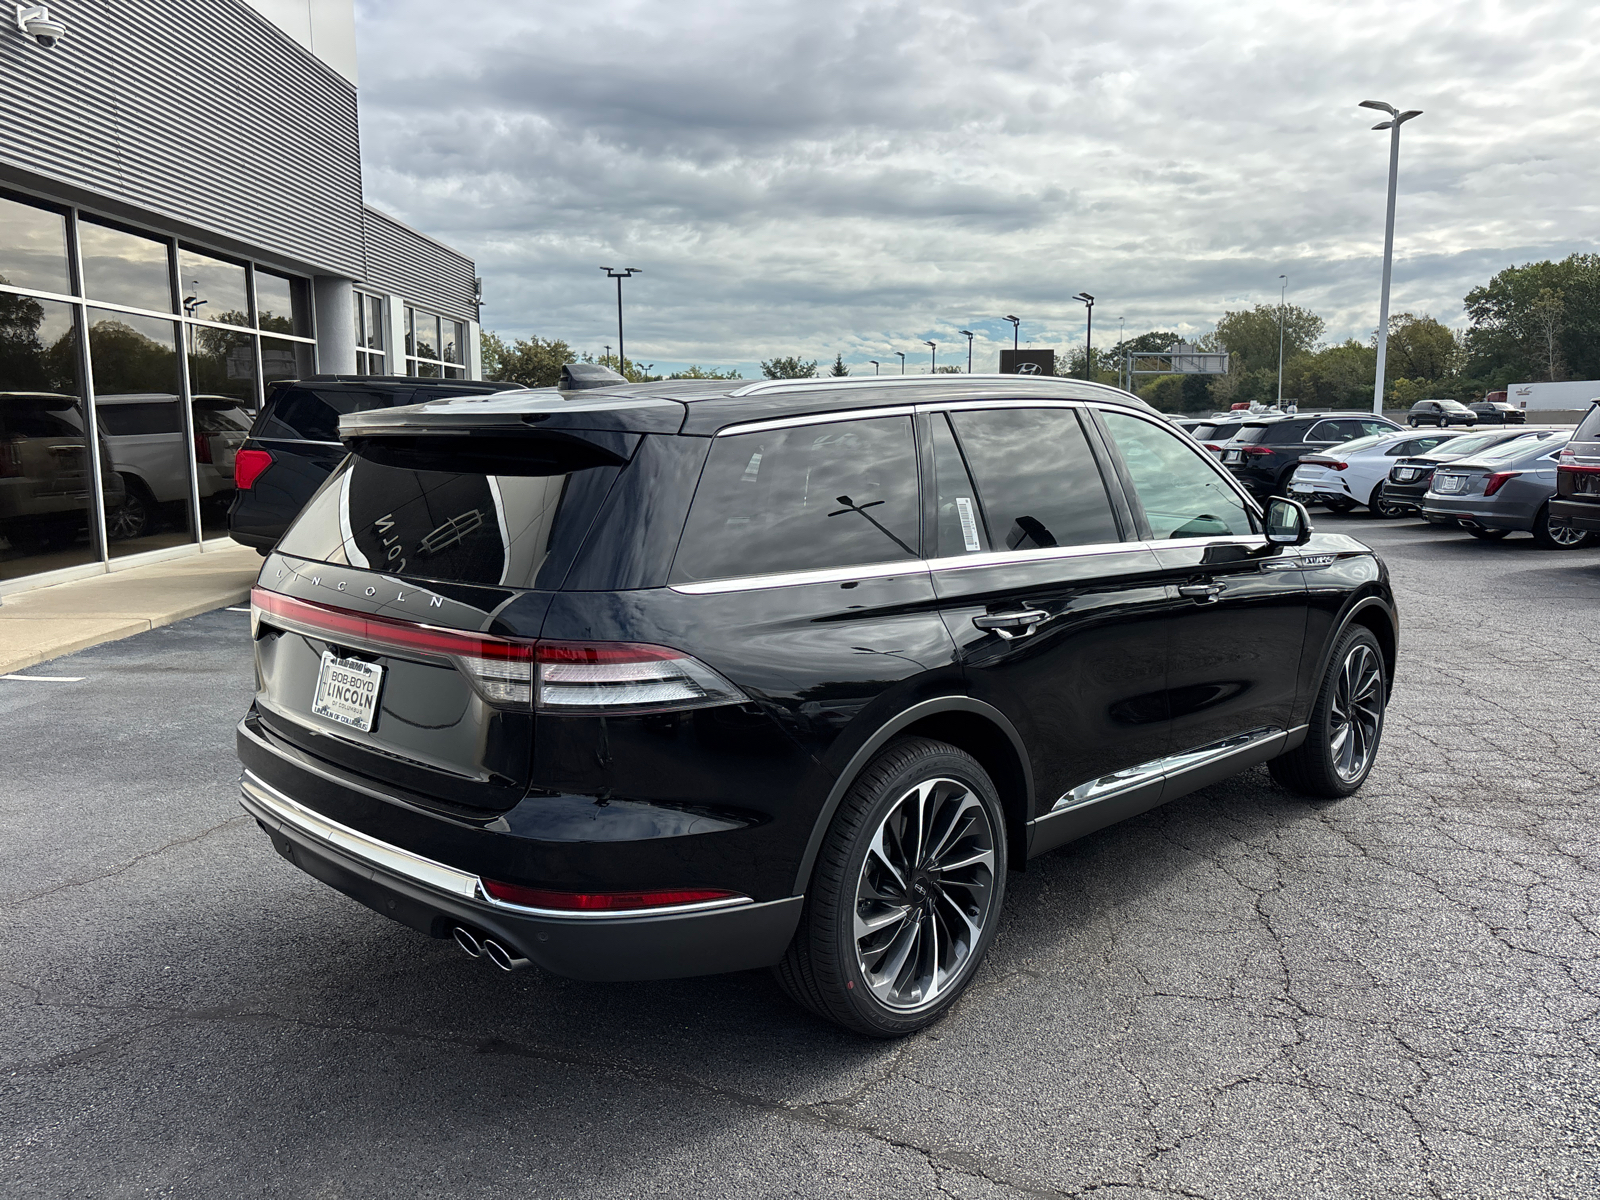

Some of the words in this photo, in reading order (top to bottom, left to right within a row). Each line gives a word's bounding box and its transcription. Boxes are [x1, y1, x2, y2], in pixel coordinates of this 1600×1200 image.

[276, 569, 444, 609] LINCOLN
[331, 671, 374, 692] BOB-BOYD
[327, 682, 374, 710] LINCOLN
[333, 713, 341, 721] OF
